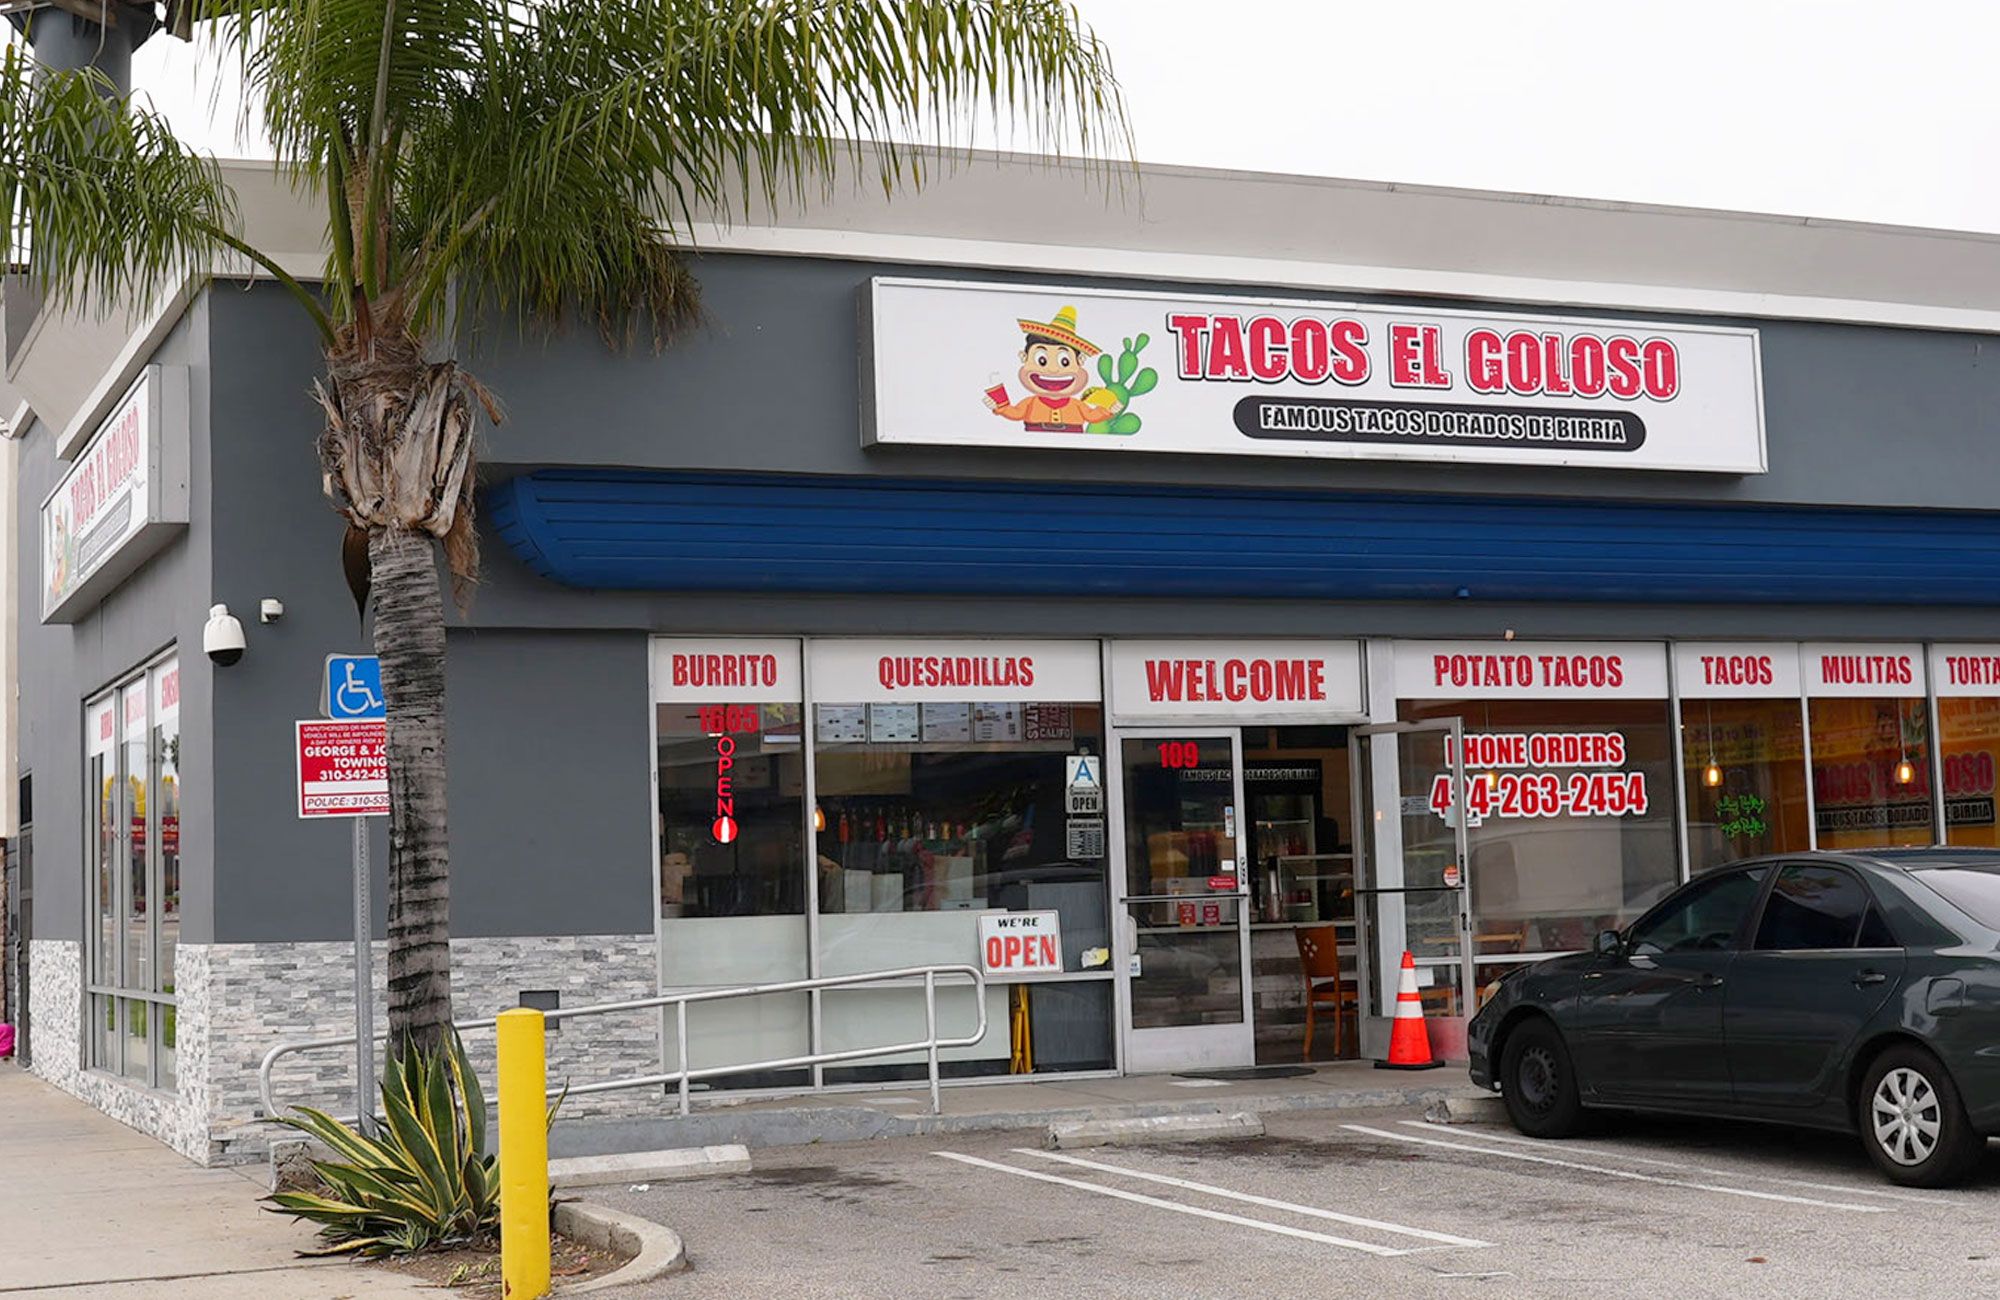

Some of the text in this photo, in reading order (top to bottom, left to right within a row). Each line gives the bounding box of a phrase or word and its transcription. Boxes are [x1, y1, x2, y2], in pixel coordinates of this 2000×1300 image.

[1168, 313, 1680, 400] TACOS EL GOLOSO
[1259, 404, 1627, 443] FAMOUS TACOS DORADOS DE BIRRIA
[672, 654, 778, 687] BURRITO
[879, 656, 1034, 689] QUESADILLAS
[1145, 658, 1326, 702] WELCOME
[1434, 654, 1624, 688] POTATO TACOS
[1701, 655, 1773, 686] TACOS
[1821, 655, 1912, 685] MULITAS
[697, 704, 759, 733] 1605
[305, 745, 356, 757] GEORGE
[360, 745, 369, 755] &
[333, 757, 387, 768] TOWING
[1157, 741, 1199, 768] 109
[1529, 733, 1626, 766] ORDERS
[717, 736, 736, 817] OPEN
[1075, 759, 1093, 781] A
[307, 797, 349, 807] POLICE:
[1072, 796, 1098, 810] OPEN
[1430, 773, 1648, 817] 44-263-2454
[998, 917, 1040, 928] WE'RE
[986, 934, 1056, 968] OPEN
